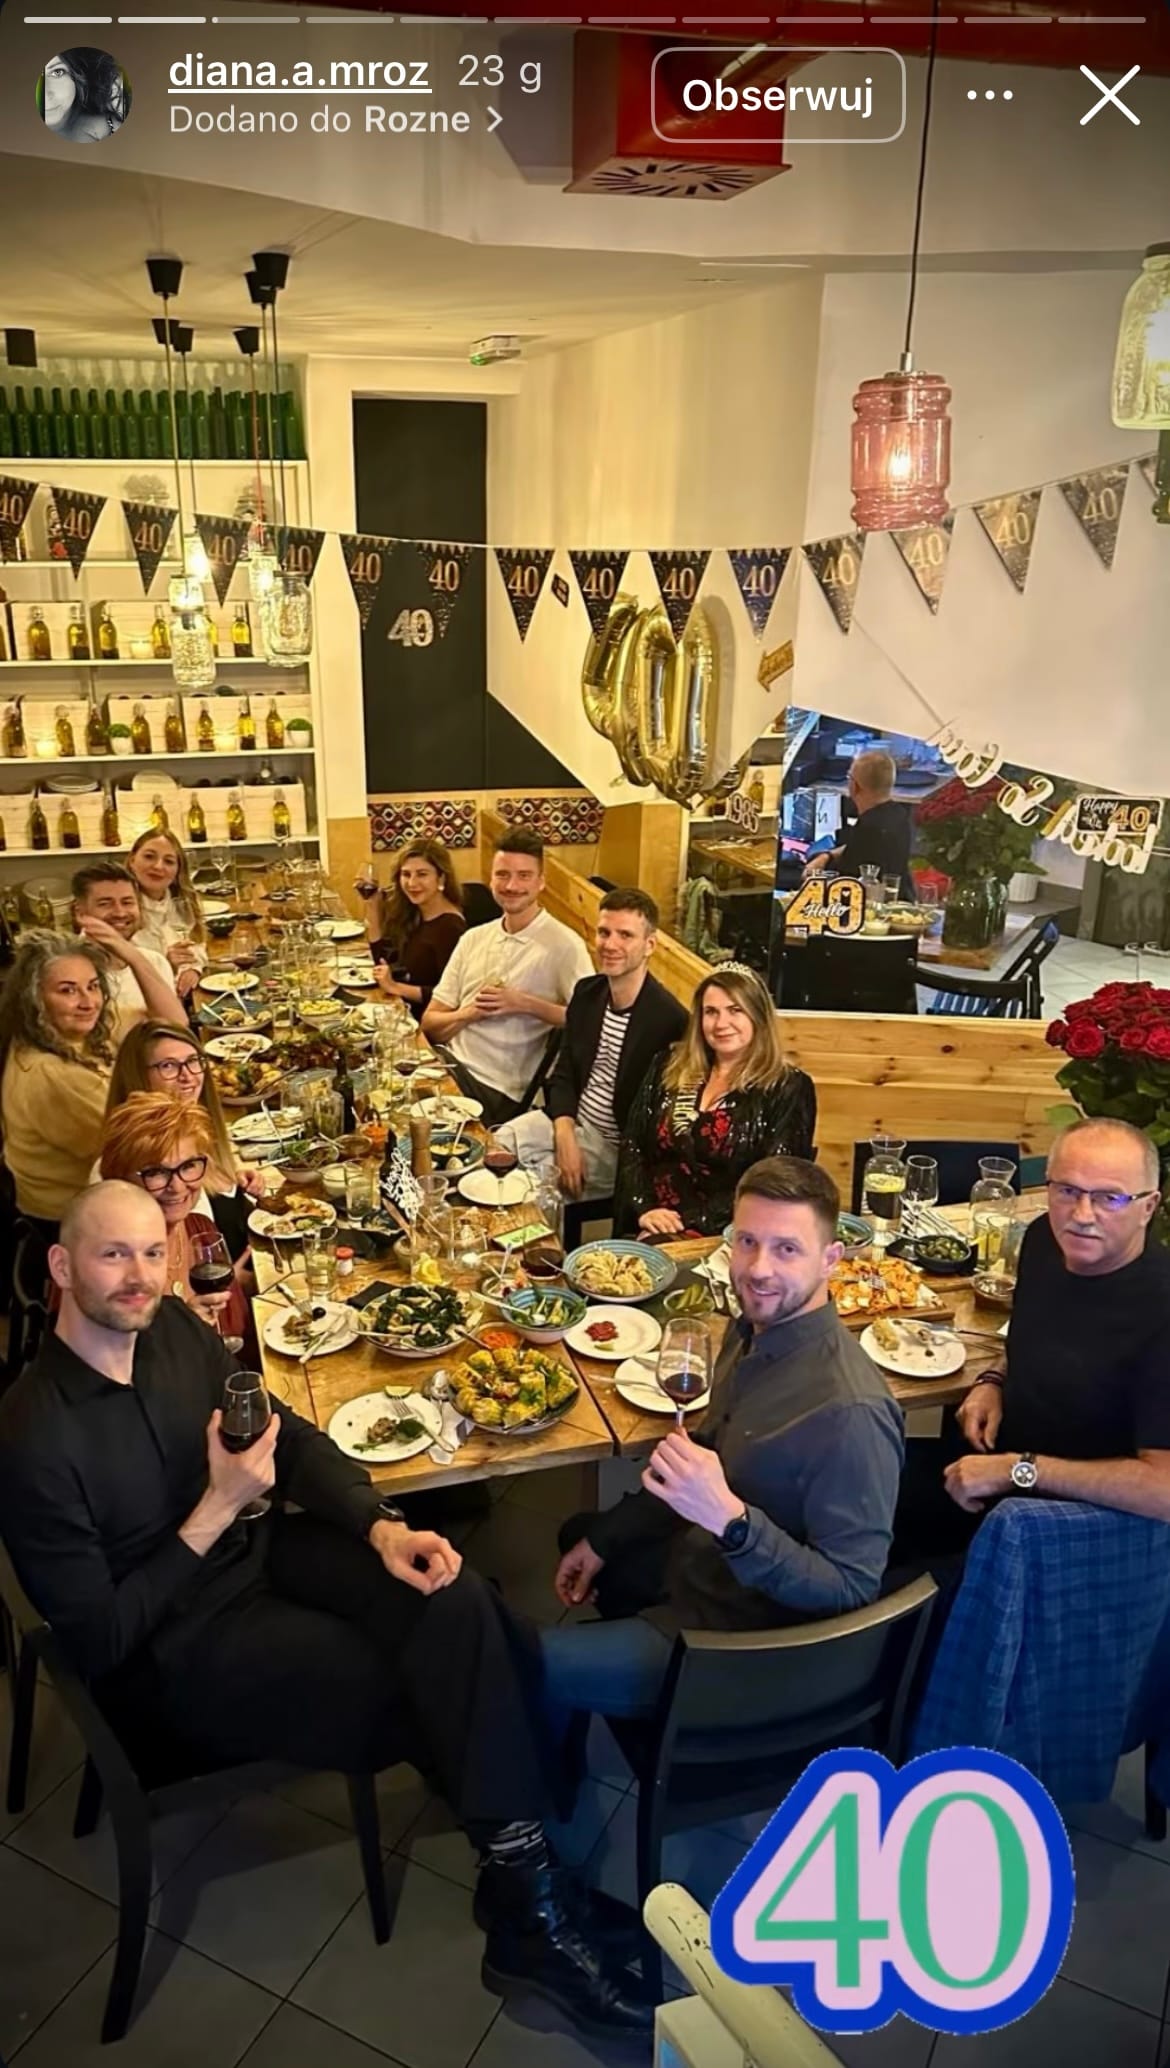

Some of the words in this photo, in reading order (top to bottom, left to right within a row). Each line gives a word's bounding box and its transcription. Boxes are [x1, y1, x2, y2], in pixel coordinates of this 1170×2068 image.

[1082, 487, 1119, 525] 40
[63, 507, 92, 539] 40
[134, 520, 163, 552] 40
[995, 509, 1032, 551] 40
[208, 534, 236, 566] 40
[907, 531, 944, 571] 40
[350, 551, 382, 584] 40
[428, 559, 460, 592] 40
[508, 565, 540, 598] 40
[583, 567, 615, 600] 40
[663, 567, 696, 600] 40
[743, 563, 776, 598] 40
[821, 551, 857, 590] 40
[387, 609, 435, 647] 40
[726, 793, 760, 834] 1985
[1108, 804, 1151, 831] 40
[785, 877, 866, 945] 40
[804, 902, 851, 918] Hello
